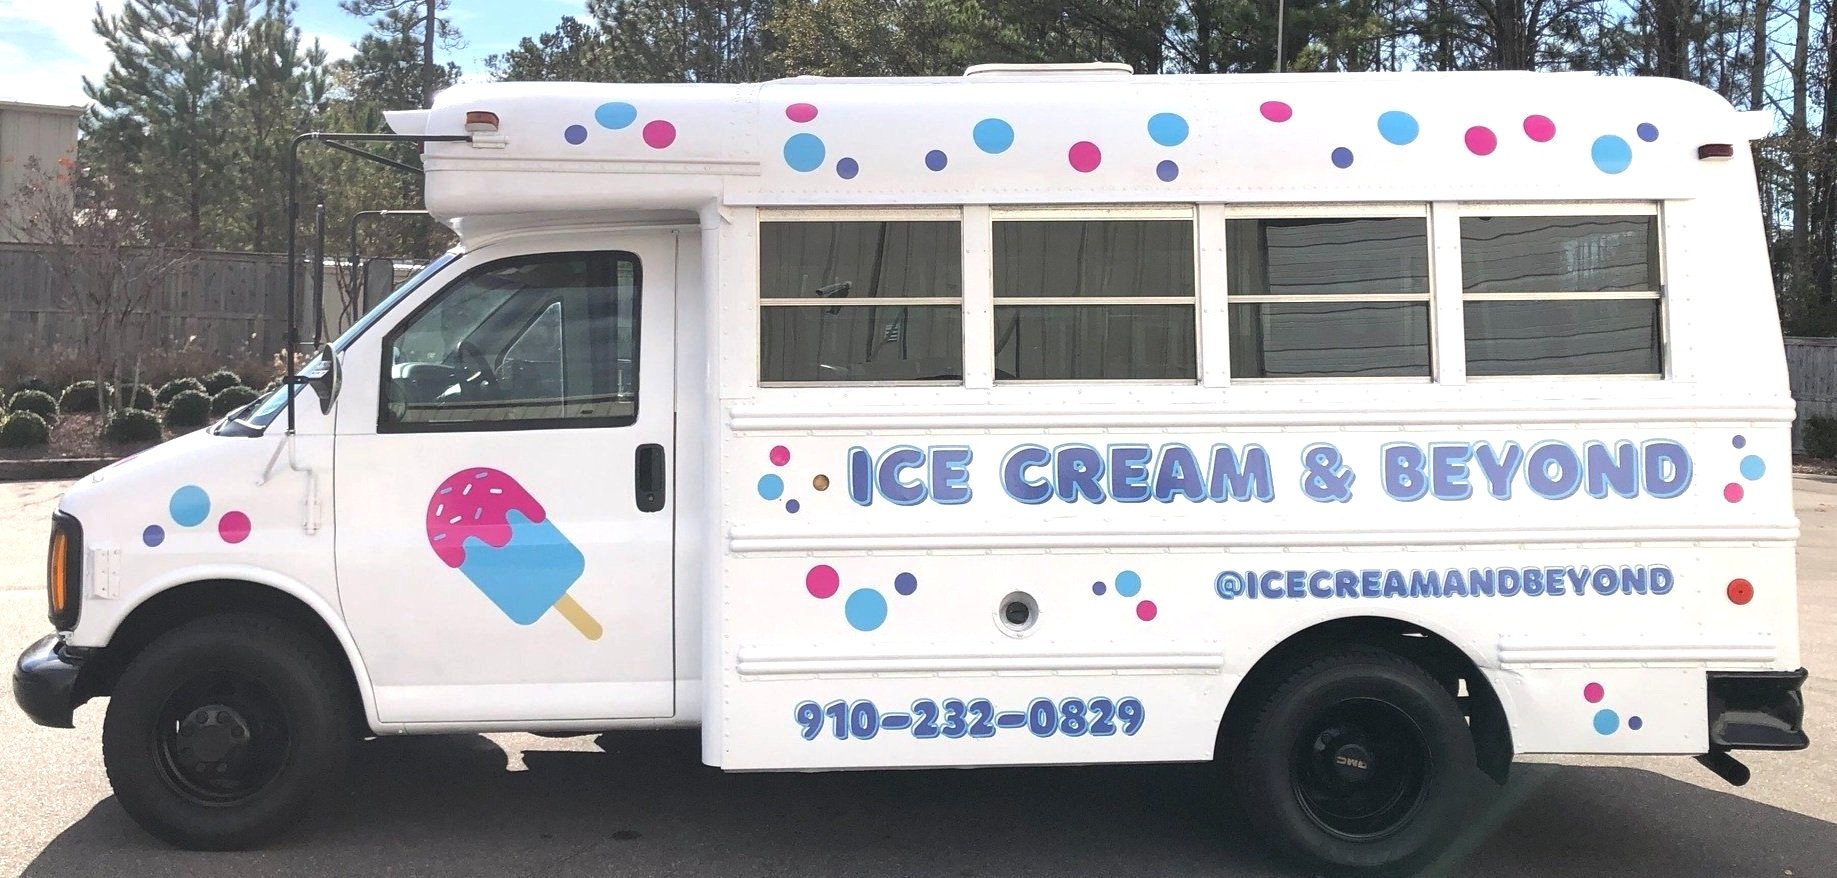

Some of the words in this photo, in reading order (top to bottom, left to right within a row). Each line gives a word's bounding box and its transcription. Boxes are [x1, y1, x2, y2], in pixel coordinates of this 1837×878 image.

[848, 444, 972, 507] ICE
[1000, 443, 1274, 505] CREAM
[1300, 441, 1355, 503] &
[1380, 439, 1693, 502] BEYOND
[1214, 564, 1675, 601] @ICECREAMANDBEYOND
[793, 697, 1145, 741] 910-232-0829
[1335, 756, 1368, 769] GMC
